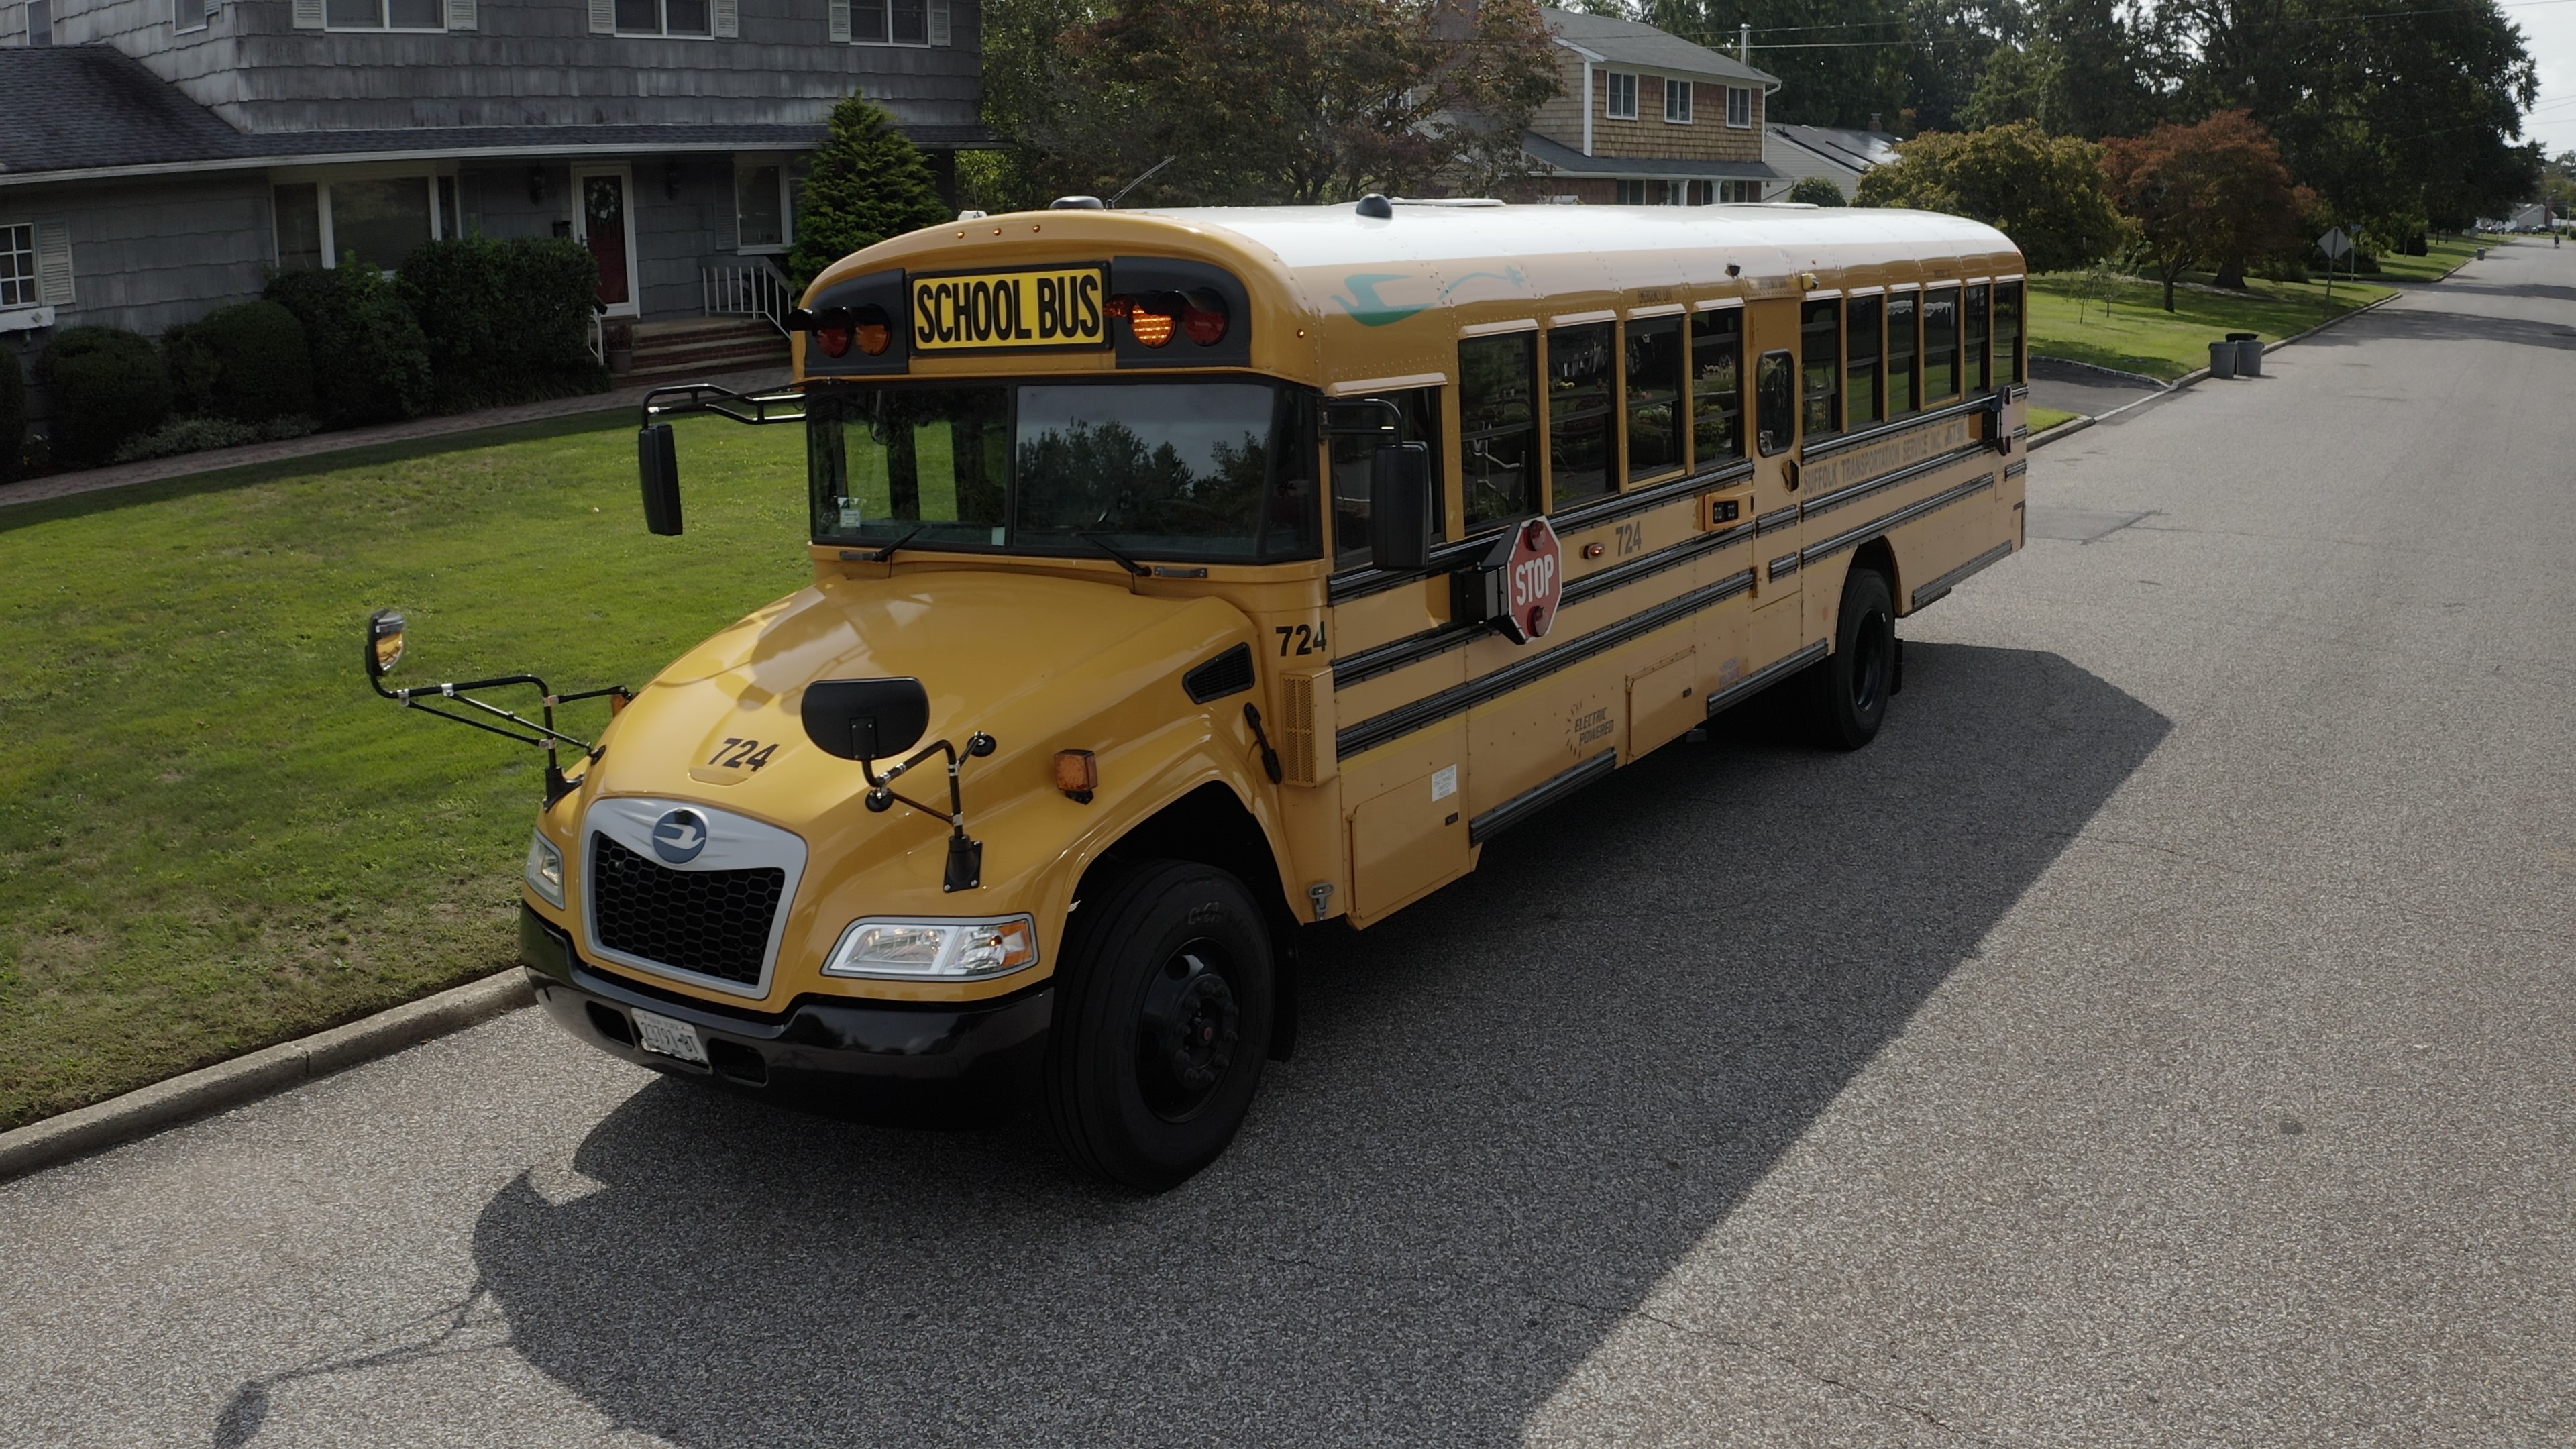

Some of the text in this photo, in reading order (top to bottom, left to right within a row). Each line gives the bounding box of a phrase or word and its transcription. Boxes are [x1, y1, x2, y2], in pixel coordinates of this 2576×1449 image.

[917, 274, 1100, 343] SCHOOL BUS
[1803, 462, 1838, 495] SUFFOLK
[1841, 442, 1900, 483] TRANSPORTATION
[1903, 433, 1927, 462] SERVICE
[1615, 521, 1642, 557] 724
[1515, 553, 1554, 606] STOP
[1276, 621, 1327, 657] 724
[1574, 706, 1608, 733] ELECTRIC
[1578, 719, 1615, 747] POWERED
[708, 737, 780, 773] 724
